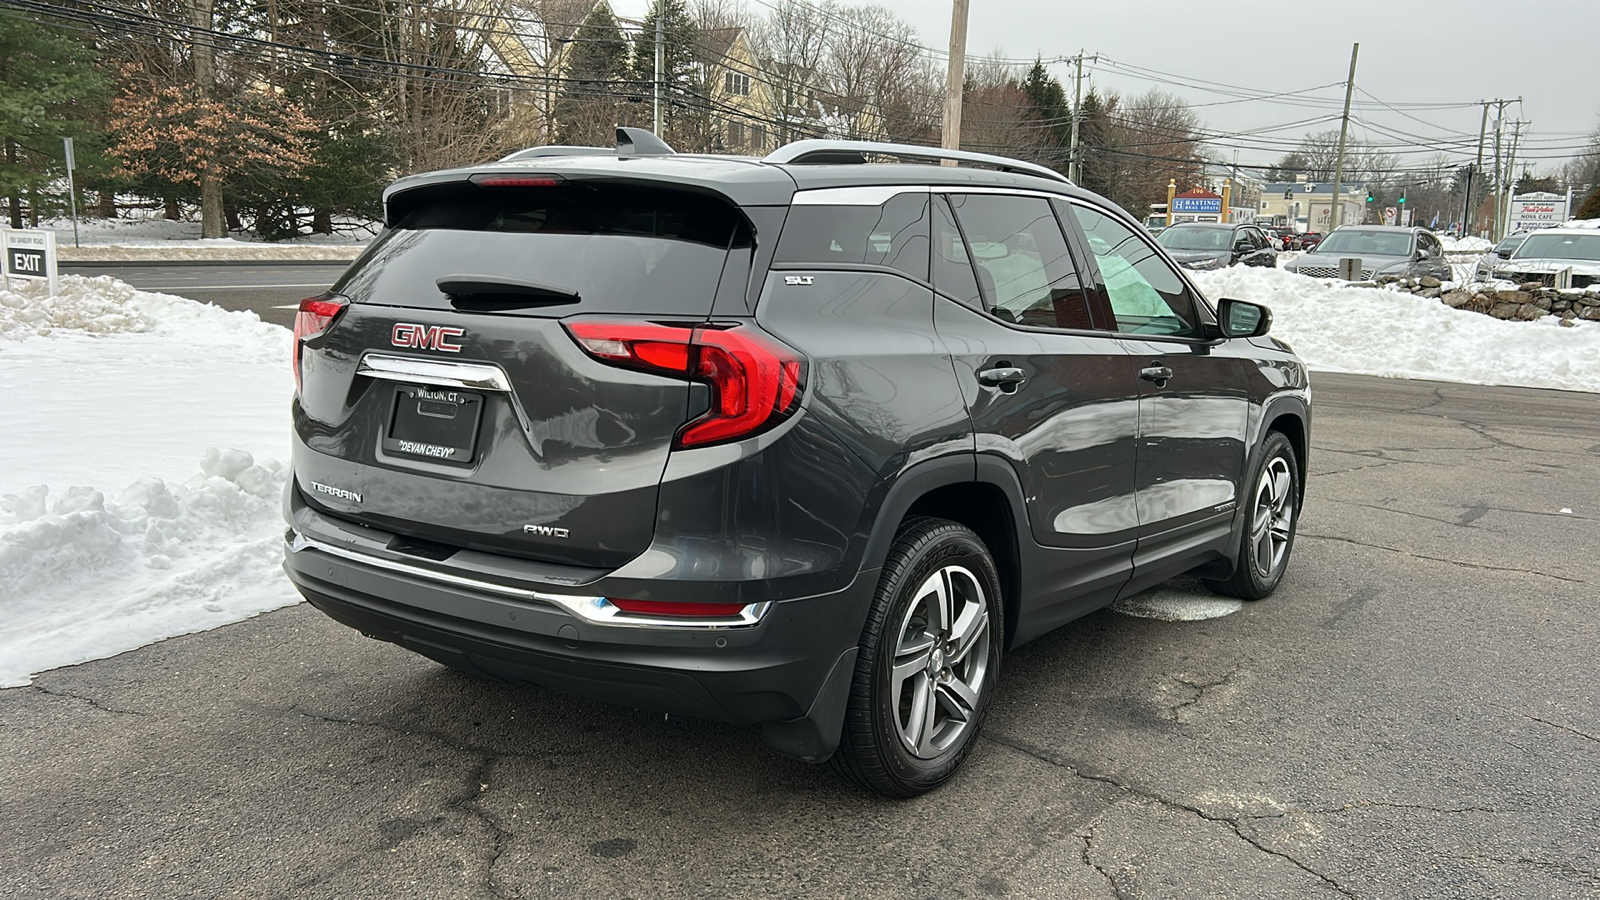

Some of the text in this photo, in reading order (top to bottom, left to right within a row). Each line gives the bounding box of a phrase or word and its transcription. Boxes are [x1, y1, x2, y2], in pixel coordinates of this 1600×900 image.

[14, 252, 41, 272] EXIT
[784, 275, 815, 286] SLT
[391, 322, 466, 353] GMC
[448, 392, 458, 402] CT
[311, 481, 363, 503] TERRAIN
[523, 524, 570, 539] AWD
